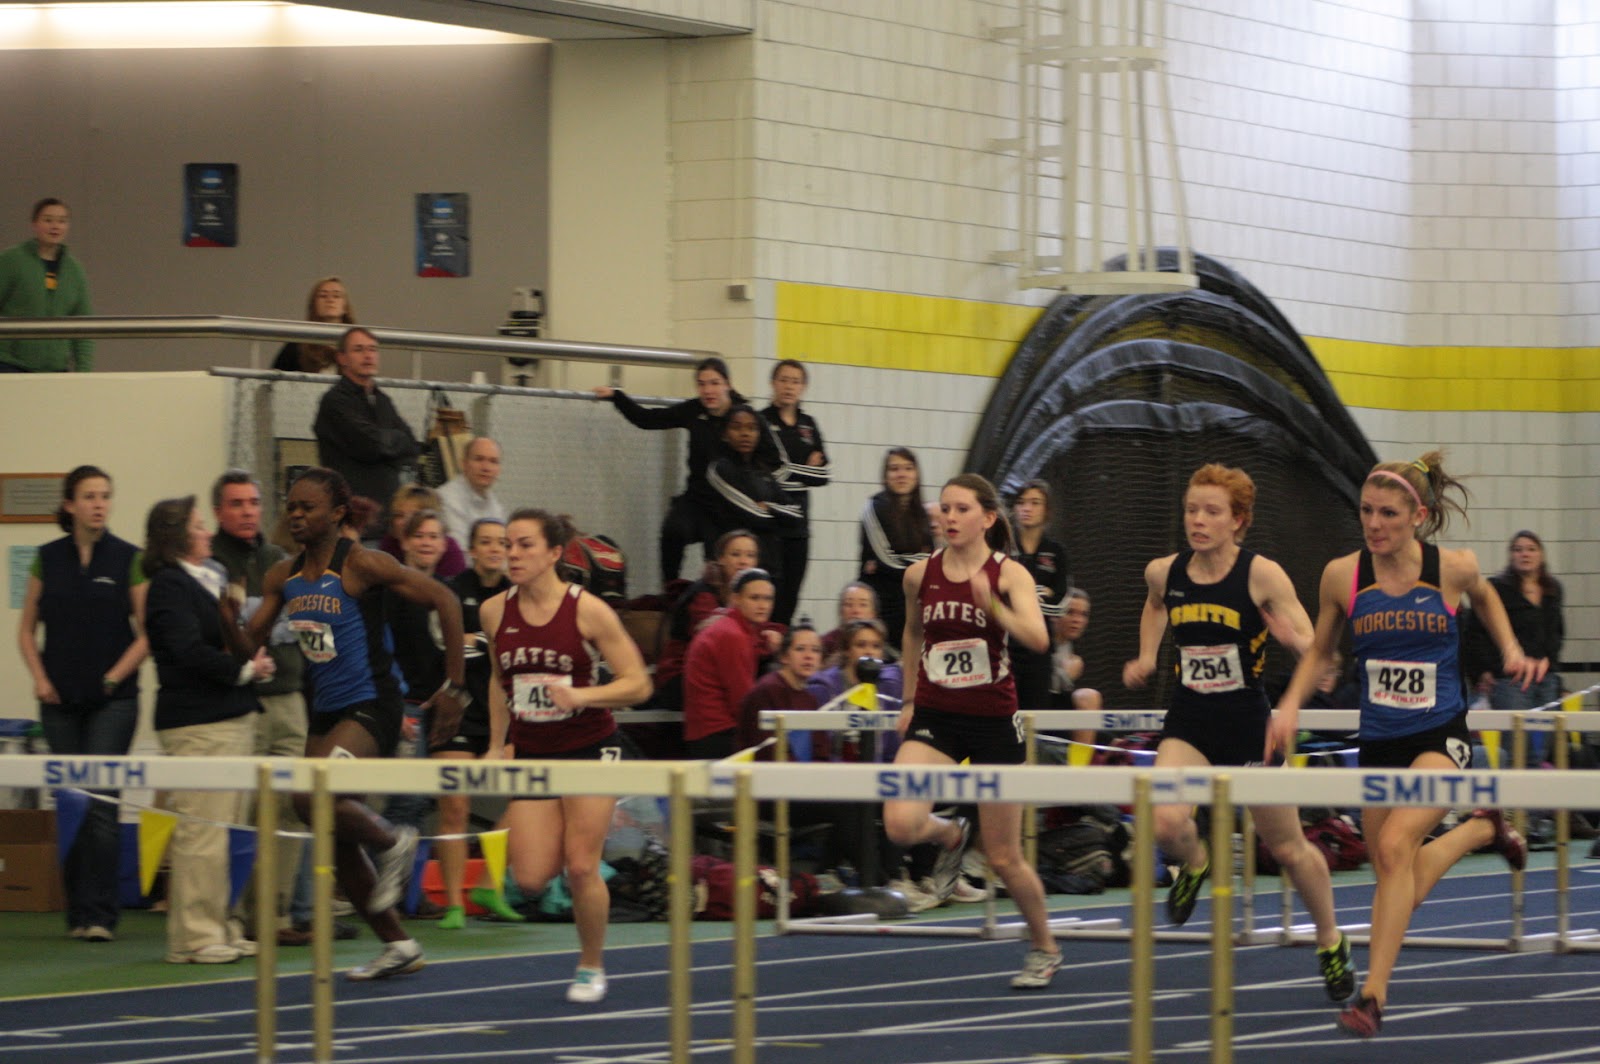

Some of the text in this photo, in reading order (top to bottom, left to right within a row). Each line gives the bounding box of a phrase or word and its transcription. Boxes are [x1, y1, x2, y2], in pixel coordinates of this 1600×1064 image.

[923, 601, 987, 628] BATES
[1170, 603, 1241, 630] SMITH
[1353, 610, 1448, 636] WORCESTER
[500, 647, 574, 672] BATES
[943, 651, 973, 675] 28
[1189, 657, 1231, 681] 254
[1378, 667, 1425, 694] 428
[848, 714, 899, 728] SMIT
[44, 760, 146, 785] SMITH
[439, 766, 549, 790] SMITH
[877, 771, 1000, 798] SMITH
[1362, 775, 1498, 803] SMITH
